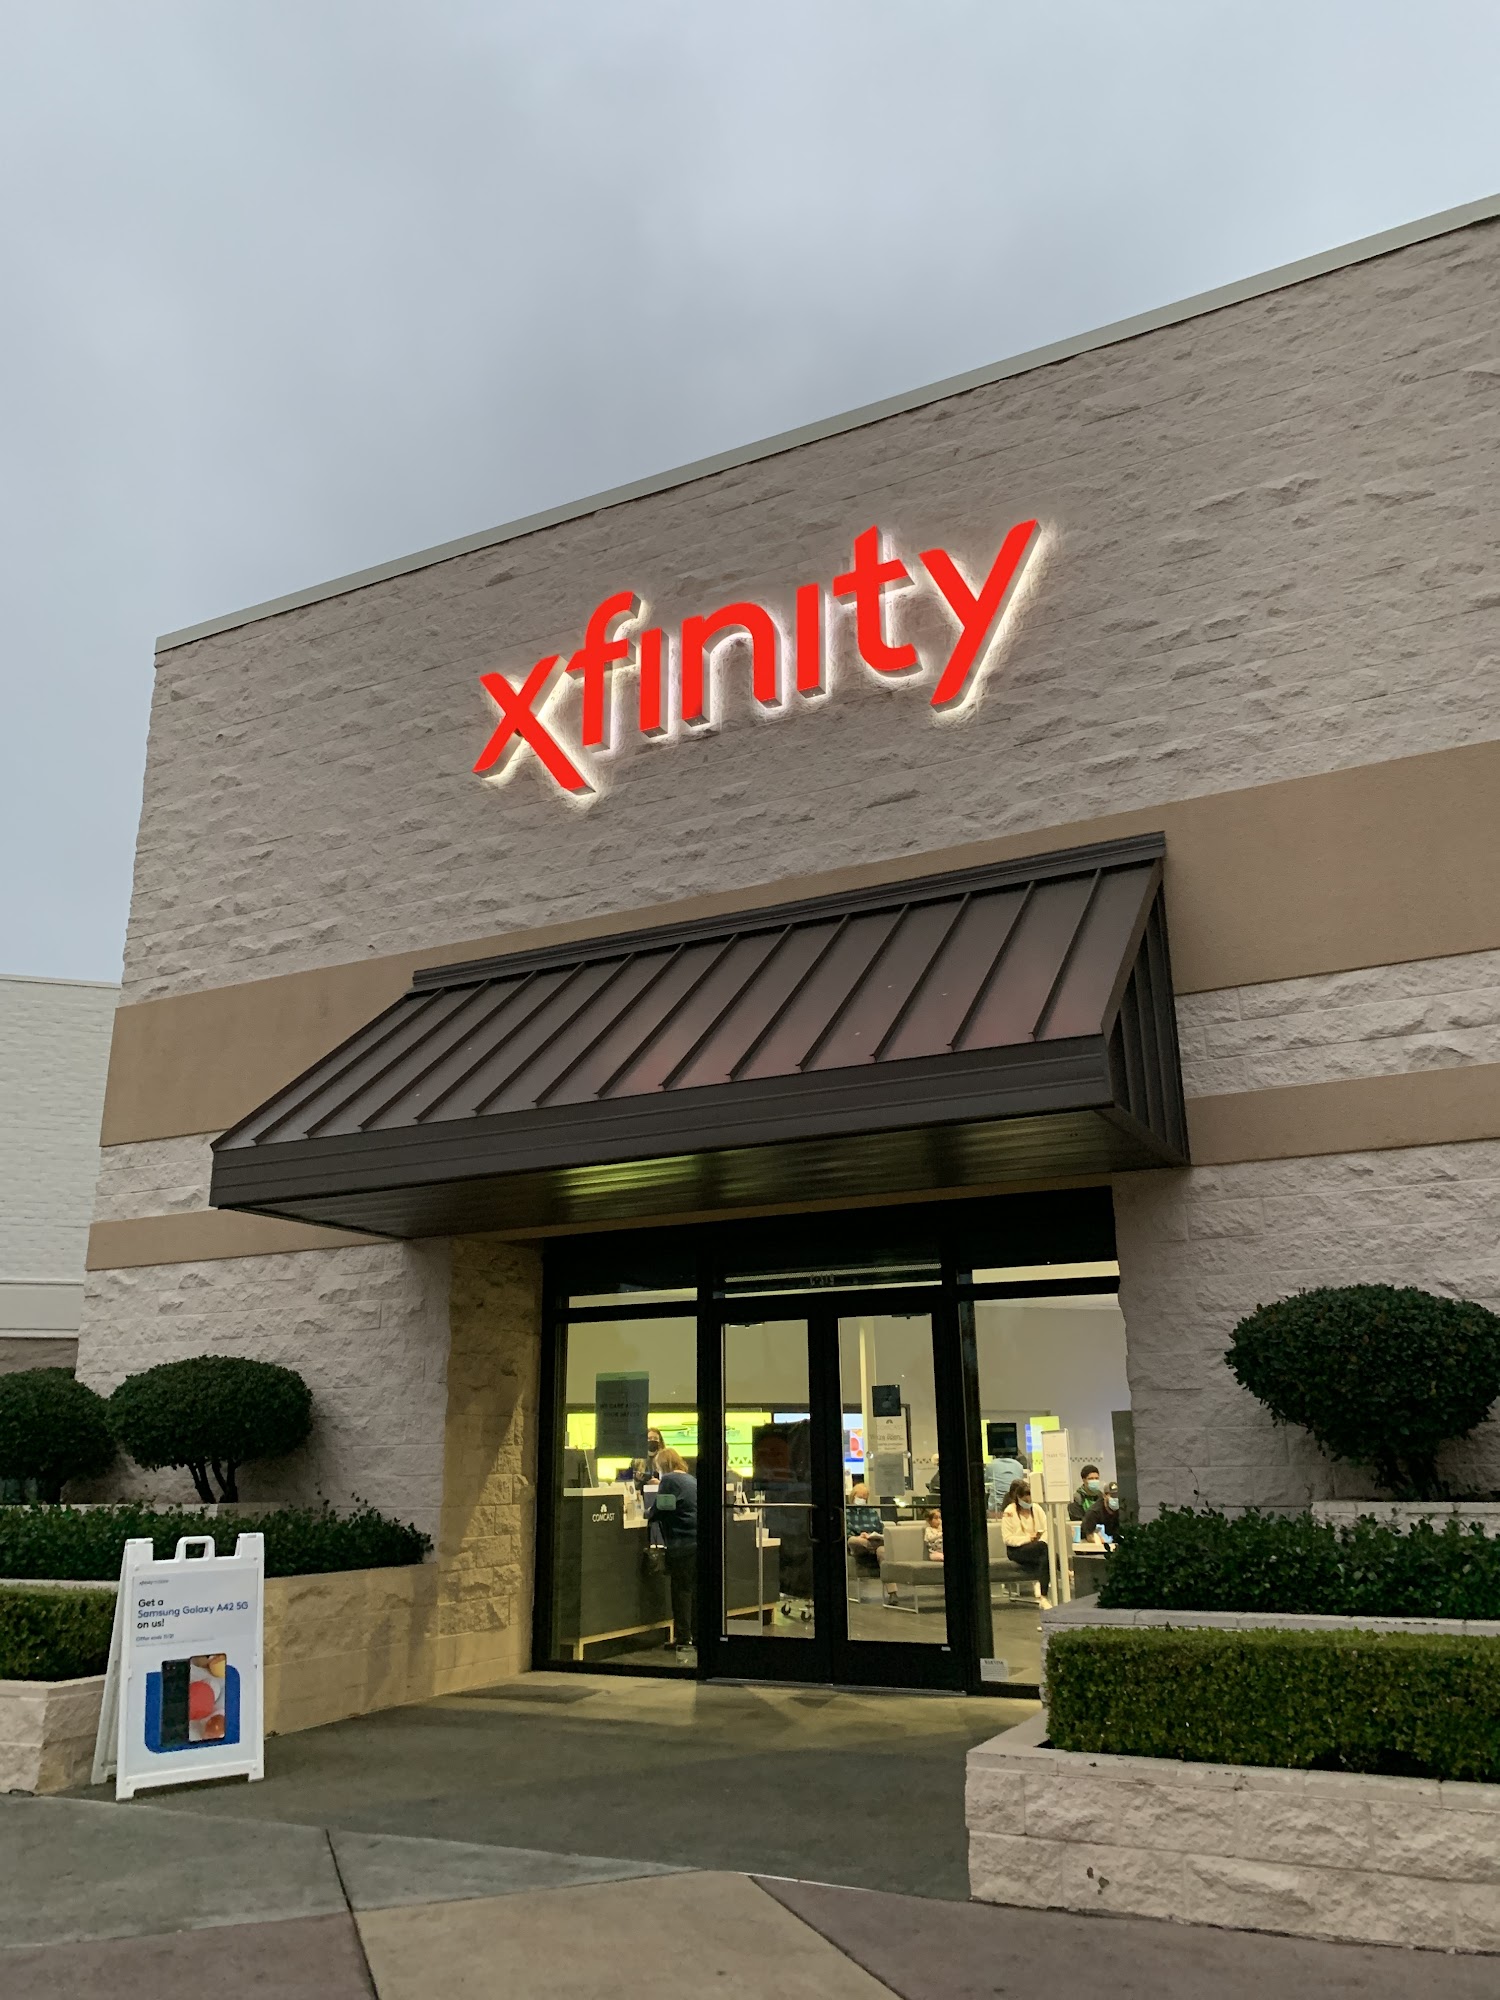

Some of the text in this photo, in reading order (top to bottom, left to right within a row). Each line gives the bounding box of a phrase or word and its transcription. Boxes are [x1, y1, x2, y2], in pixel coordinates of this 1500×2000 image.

[472, 519, 1041, 794] xfinity
[591, 1512, 616, 1523] COMCAST
[138, 1599, 155, 1608] Get
[138, 1601, 249, 1618] Samsung Galaxy A42 5G
[137, 1619, 165, 1629] on us!
